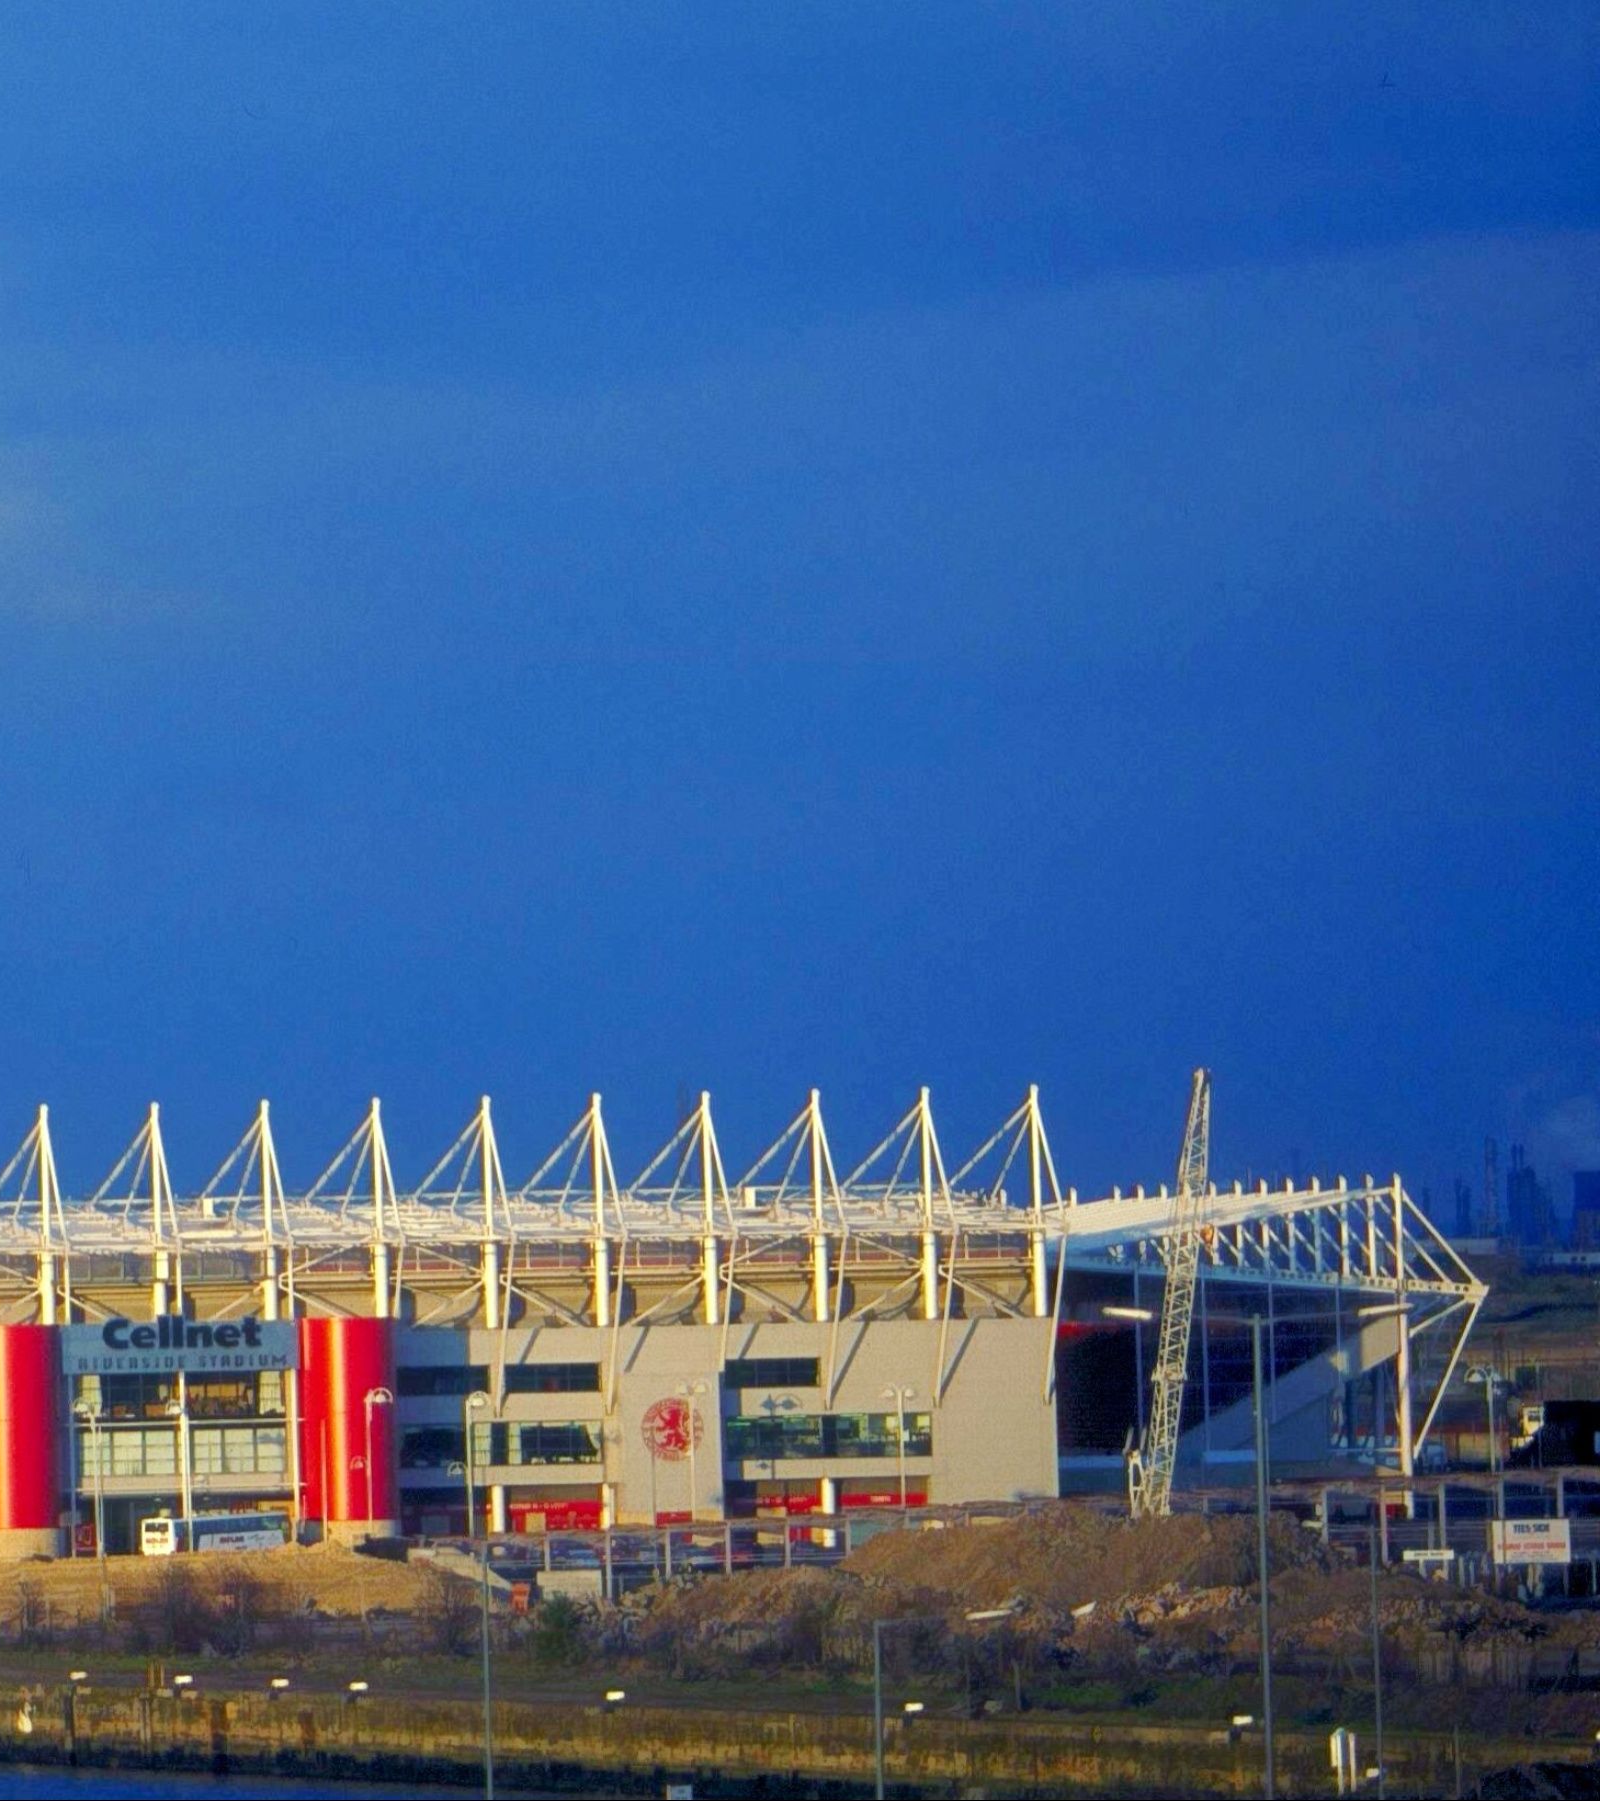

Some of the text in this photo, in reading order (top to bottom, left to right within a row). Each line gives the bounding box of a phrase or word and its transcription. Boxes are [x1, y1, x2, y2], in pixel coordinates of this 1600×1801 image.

[102, 1315, 262, 1349] Cellnet
[78, 1353, 288, 1370] RIVERSIDE STADIUM
